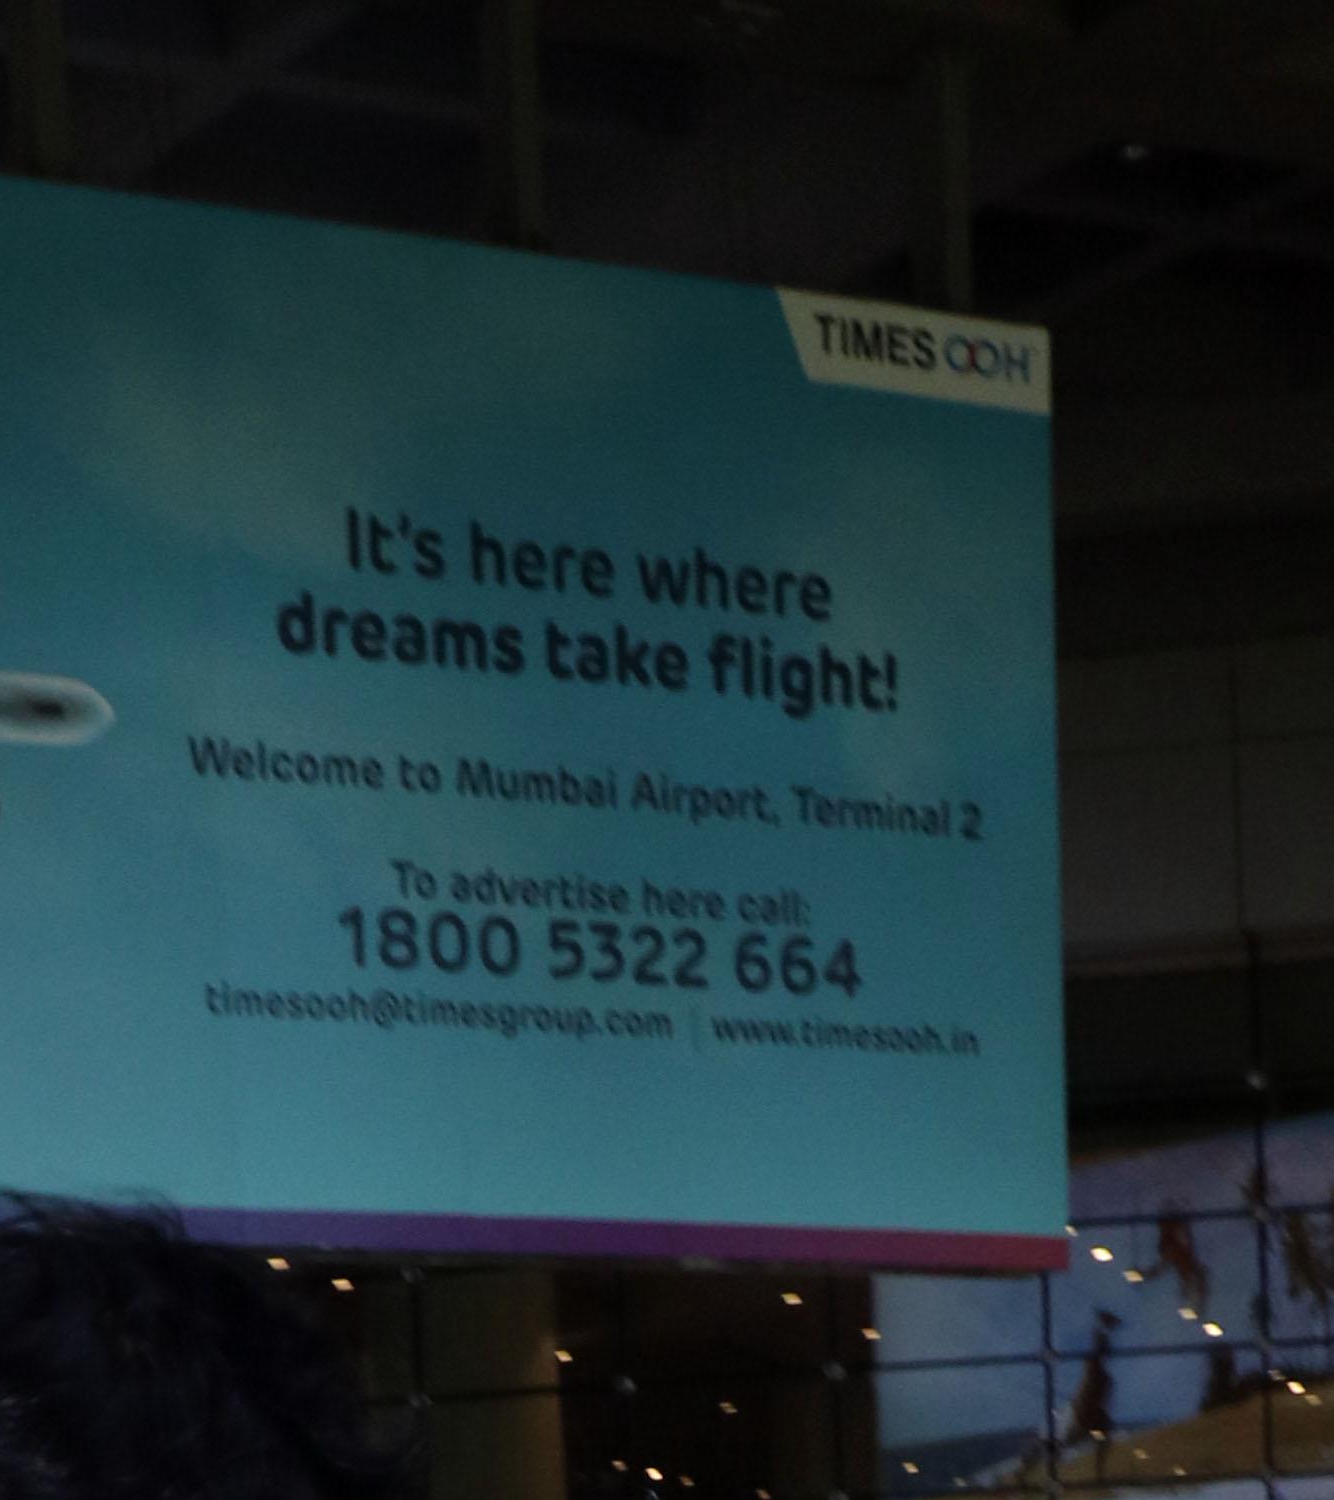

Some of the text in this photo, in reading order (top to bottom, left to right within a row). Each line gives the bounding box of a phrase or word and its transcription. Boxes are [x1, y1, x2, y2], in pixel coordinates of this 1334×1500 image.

[813, 313, 1031, 385] TIMES OOH
[346, 507, 832, 623] It's here where
[278, 591, 898, 718] dreams take flight!
[187, 735, 984, 842] Welcome to Mumbai Airport, Terminal 2
[390, 857, 810, 928] To advertise here call:
[339, 905, 862, 997] 1800 5322 664
[204, 979, 673, 1041] timesooh@timesgroup.com
